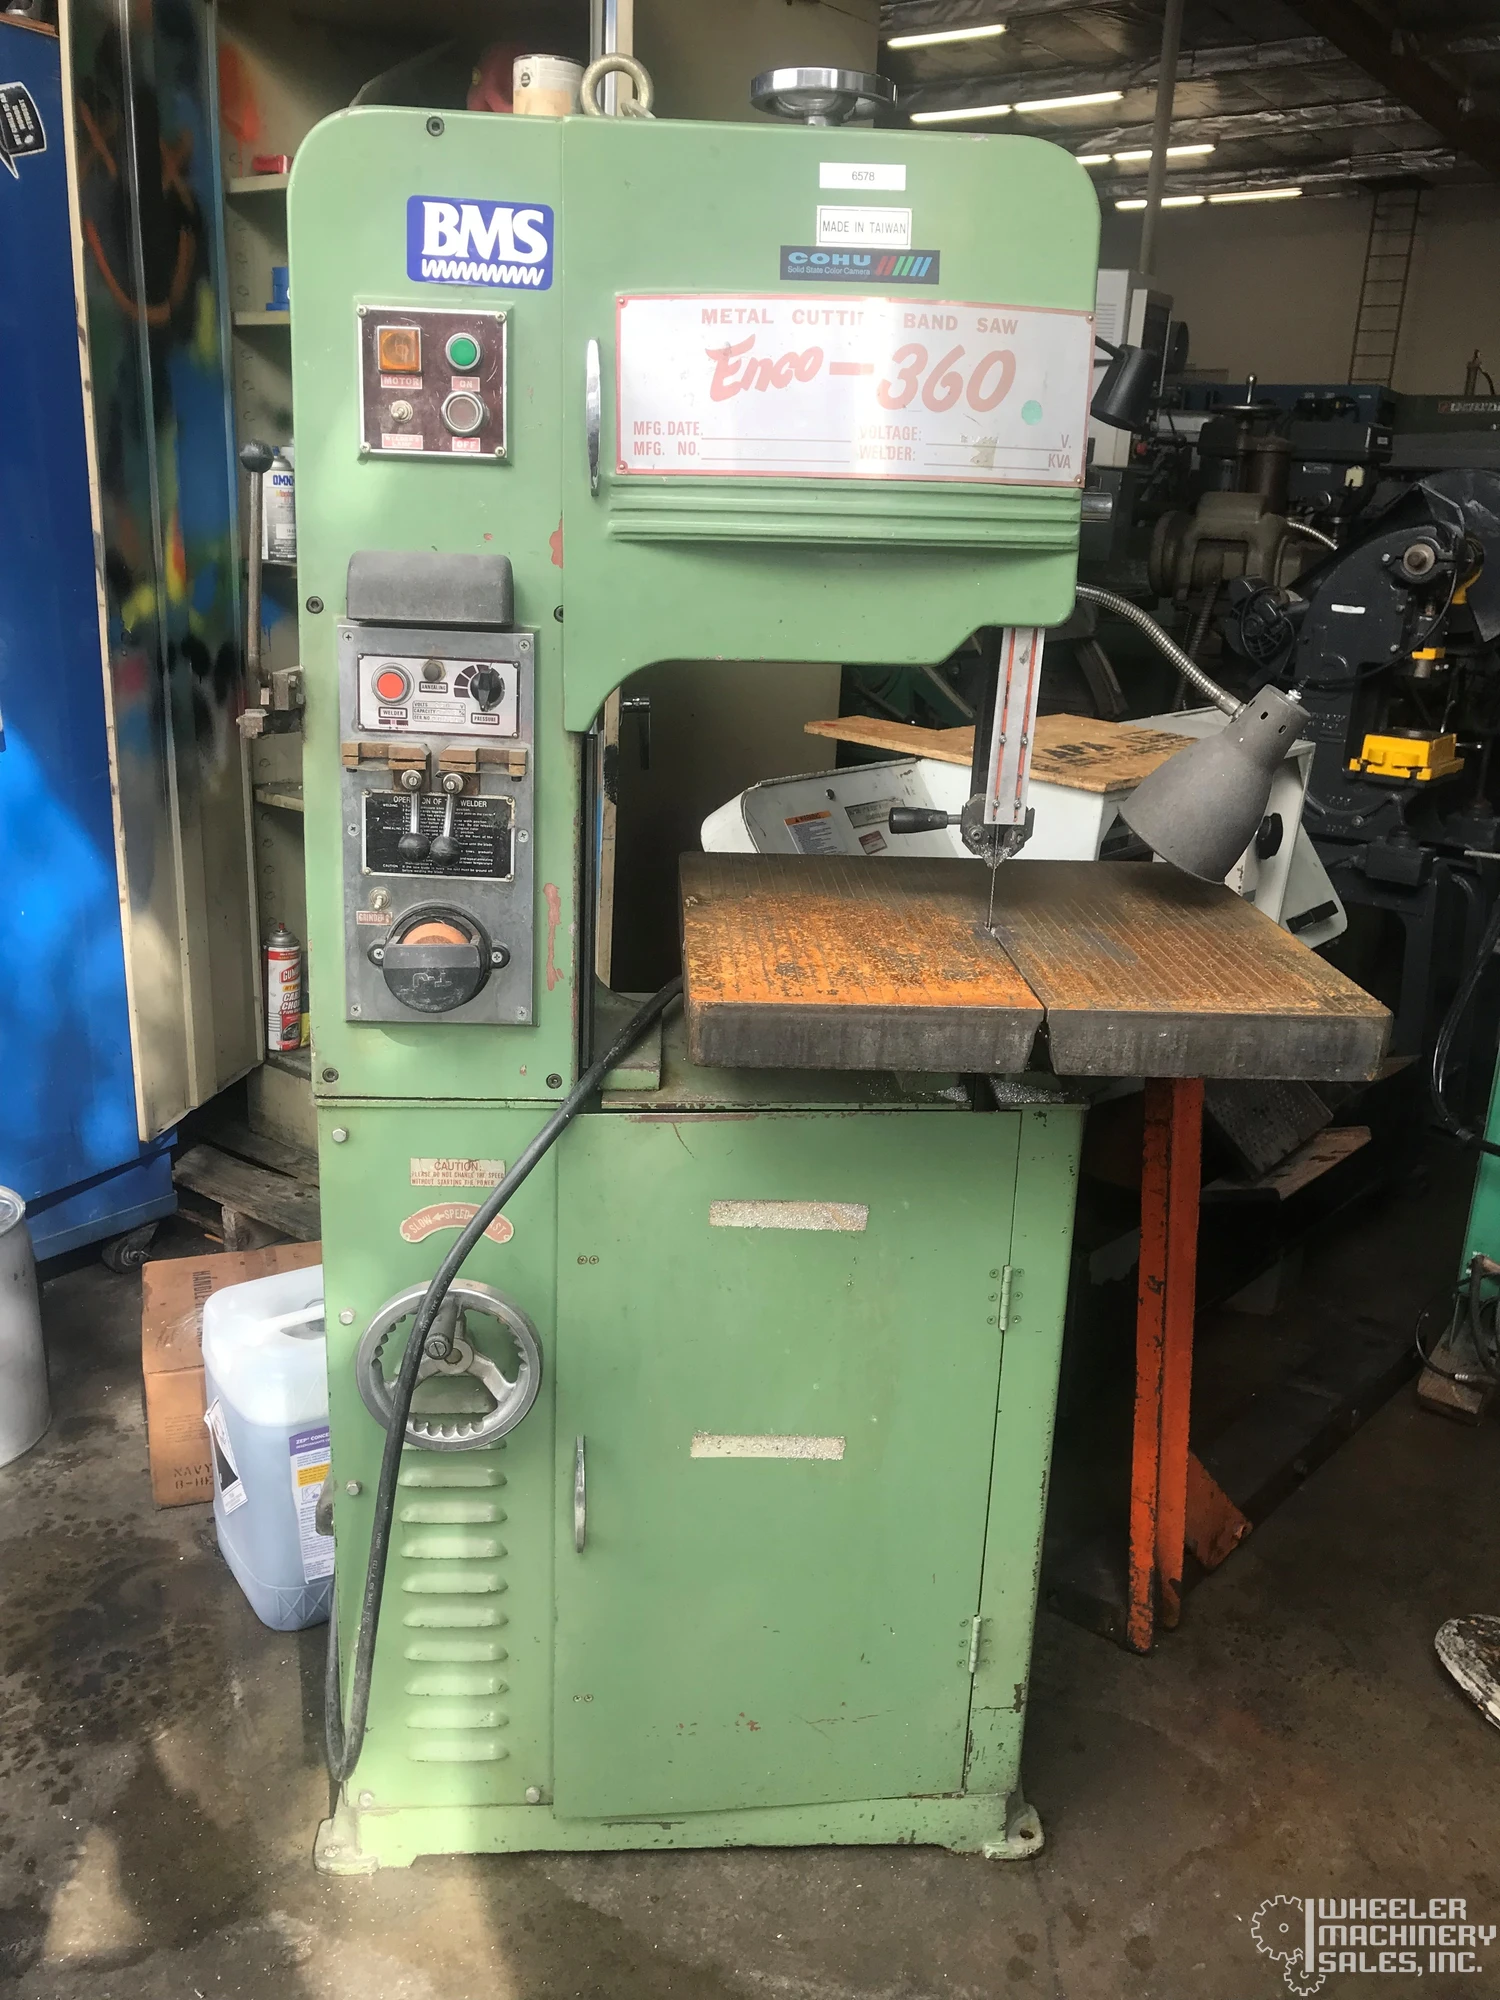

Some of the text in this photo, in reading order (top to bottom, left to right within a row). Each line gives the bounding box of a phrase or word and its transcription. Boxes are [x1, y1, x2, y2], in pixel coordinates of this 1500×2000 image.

[851, 171, 876, 182] 6578
[421, 201, 549, 265] BMS
[822, 220, 907, 235] MADE IN TAIWAN
[788, 251, 872, 267] COHU
[787, 265, 871, 276] Solid State Color Camera
[701, 308, 775, 325] METAL
[903, 313, 959, 332] BAND
[976, 317, 1019, 335] SAW
[383, 377, 420, 387] MOTOR
[459, 380, 473, 389] ON
[456, 440, 477, 449] OFF
[633, 441, 700, 456] MFG. NO.
[1047, 454, 1072, 470] KVA
[421, 684, 447, 692] ANNEALING
[382, 709, 404, 717] WELDER
[460, 799, 488, 808] WELDER
[433, 1161, 482, 1172] CAUTION:
[408, 1214, 433, 1234] SLOW
[444, 1208, 471, 1220] SPEED
